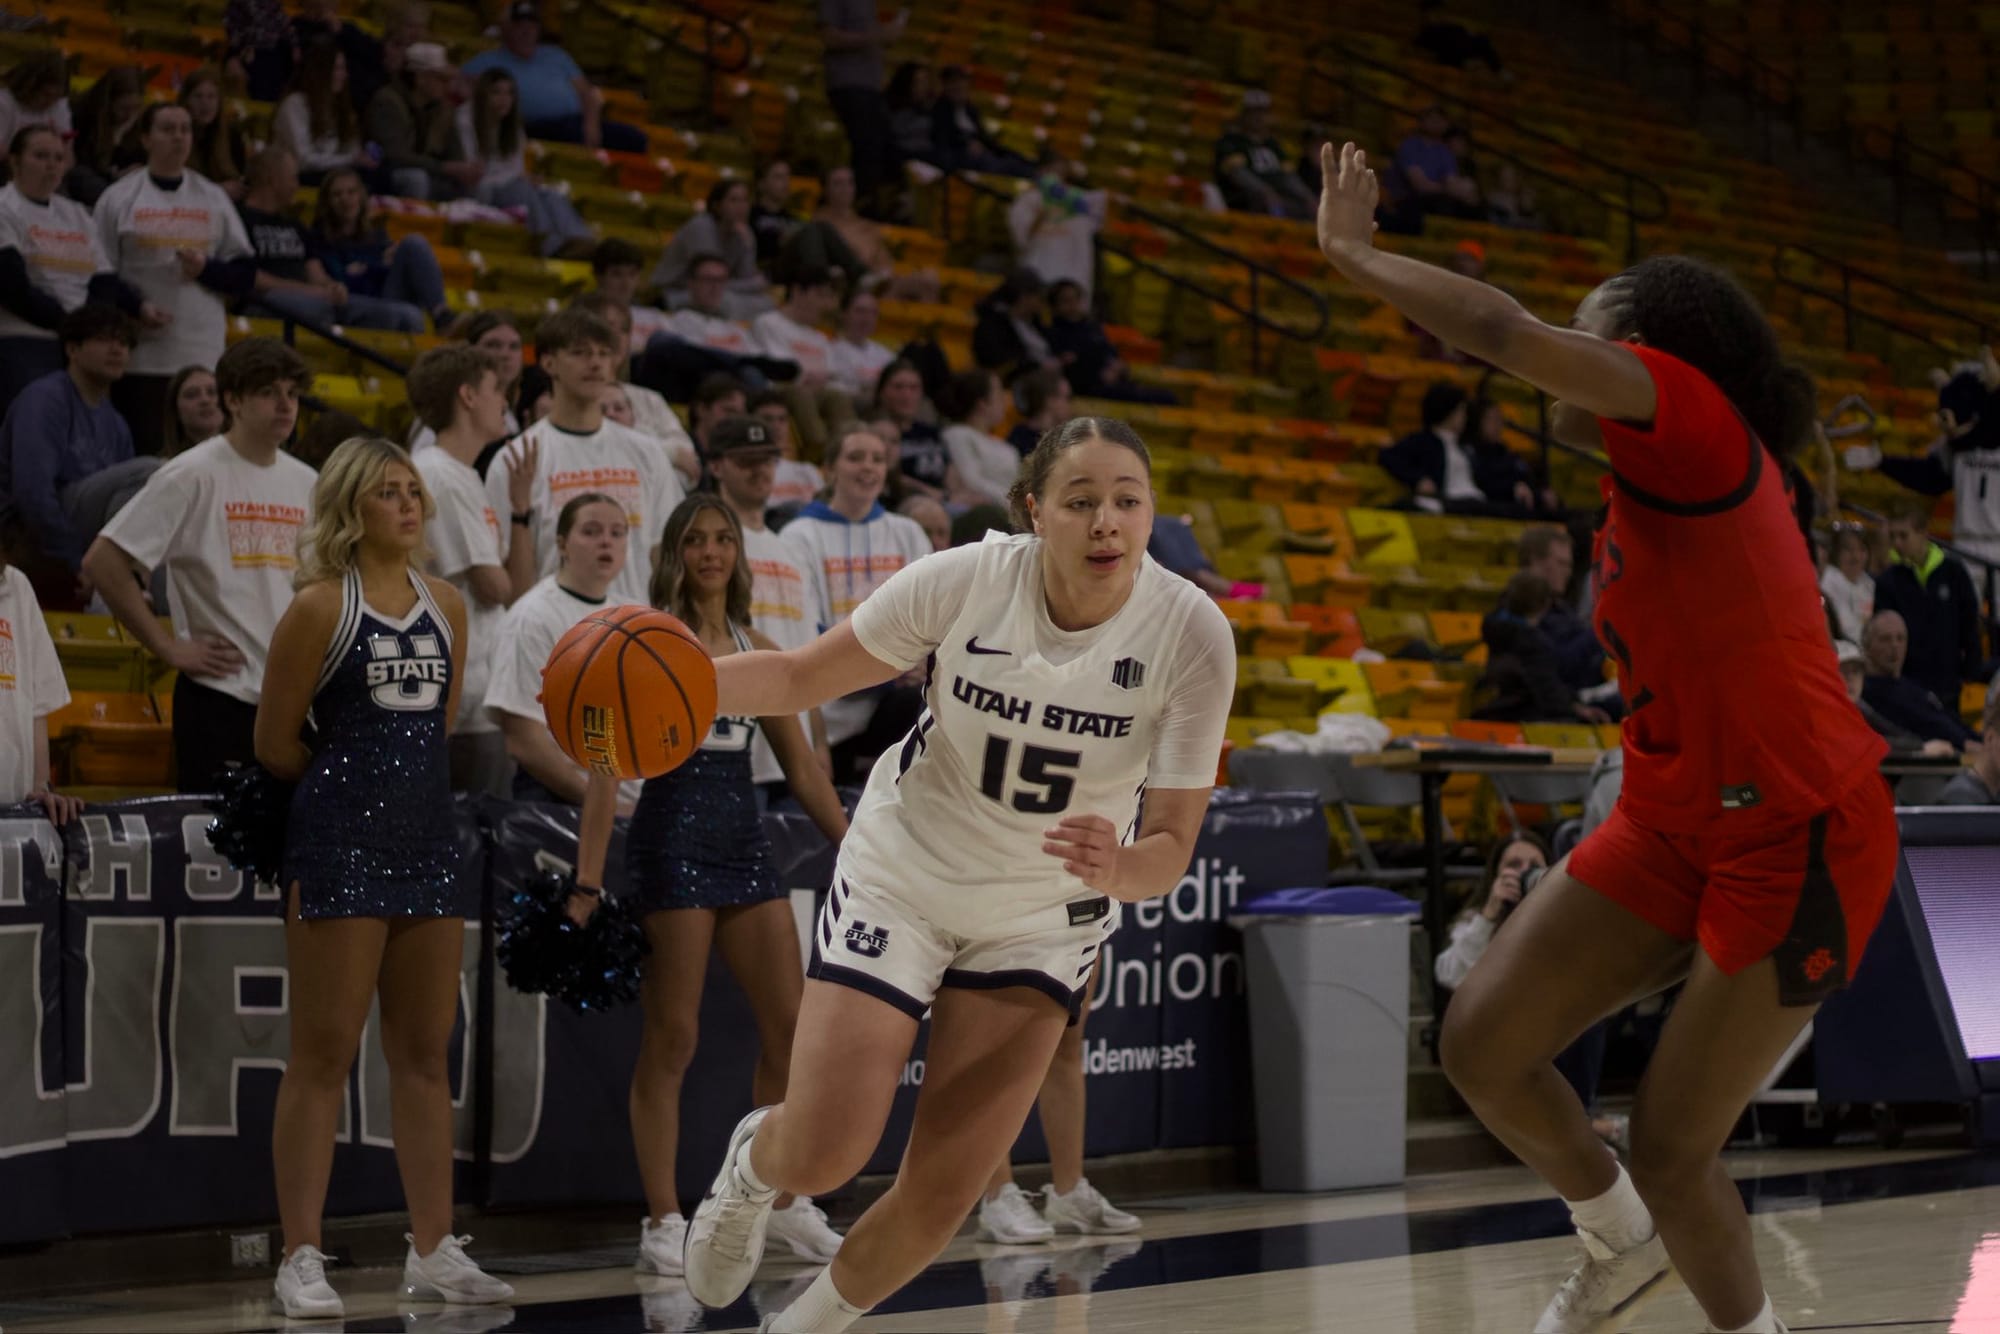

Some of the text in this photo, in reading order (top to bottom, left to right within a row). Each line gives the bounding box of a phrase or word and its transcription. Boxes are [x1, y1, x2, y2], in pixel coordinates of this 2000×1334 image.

[225, 501, 264, 515] UTAH
[366, 658, 447, 687] STATE
[953, 676, 1134, 738] UTAH STATE
[980, 734, 1082, 814] 15
[1116, 858, 1246, 930] edit
[845, 928, 889, 952] STATE
